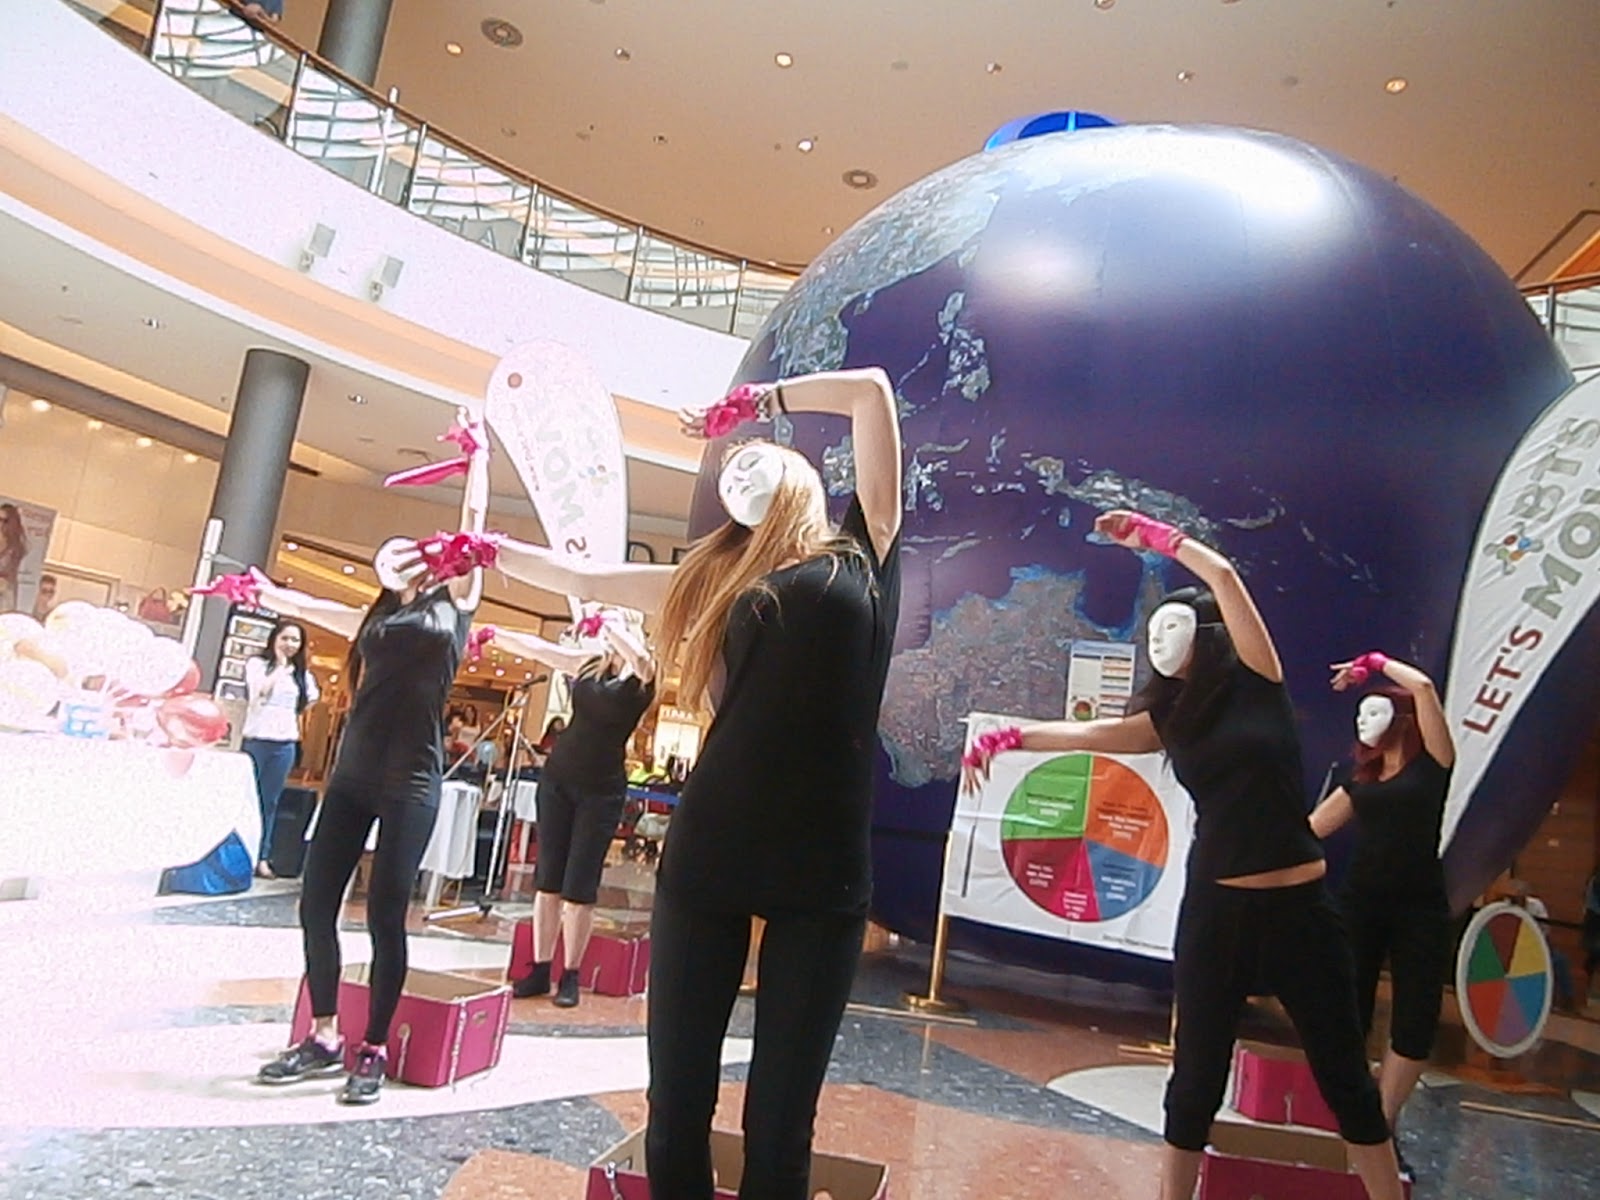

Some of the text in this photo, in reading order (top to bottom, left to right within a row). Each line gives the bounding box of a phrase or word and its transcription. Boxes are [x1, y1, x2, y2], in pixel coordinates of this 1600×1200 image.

[1508, 417, 1600, 523] BTS
[1461, 464, 1600, 734] LET'S MO
